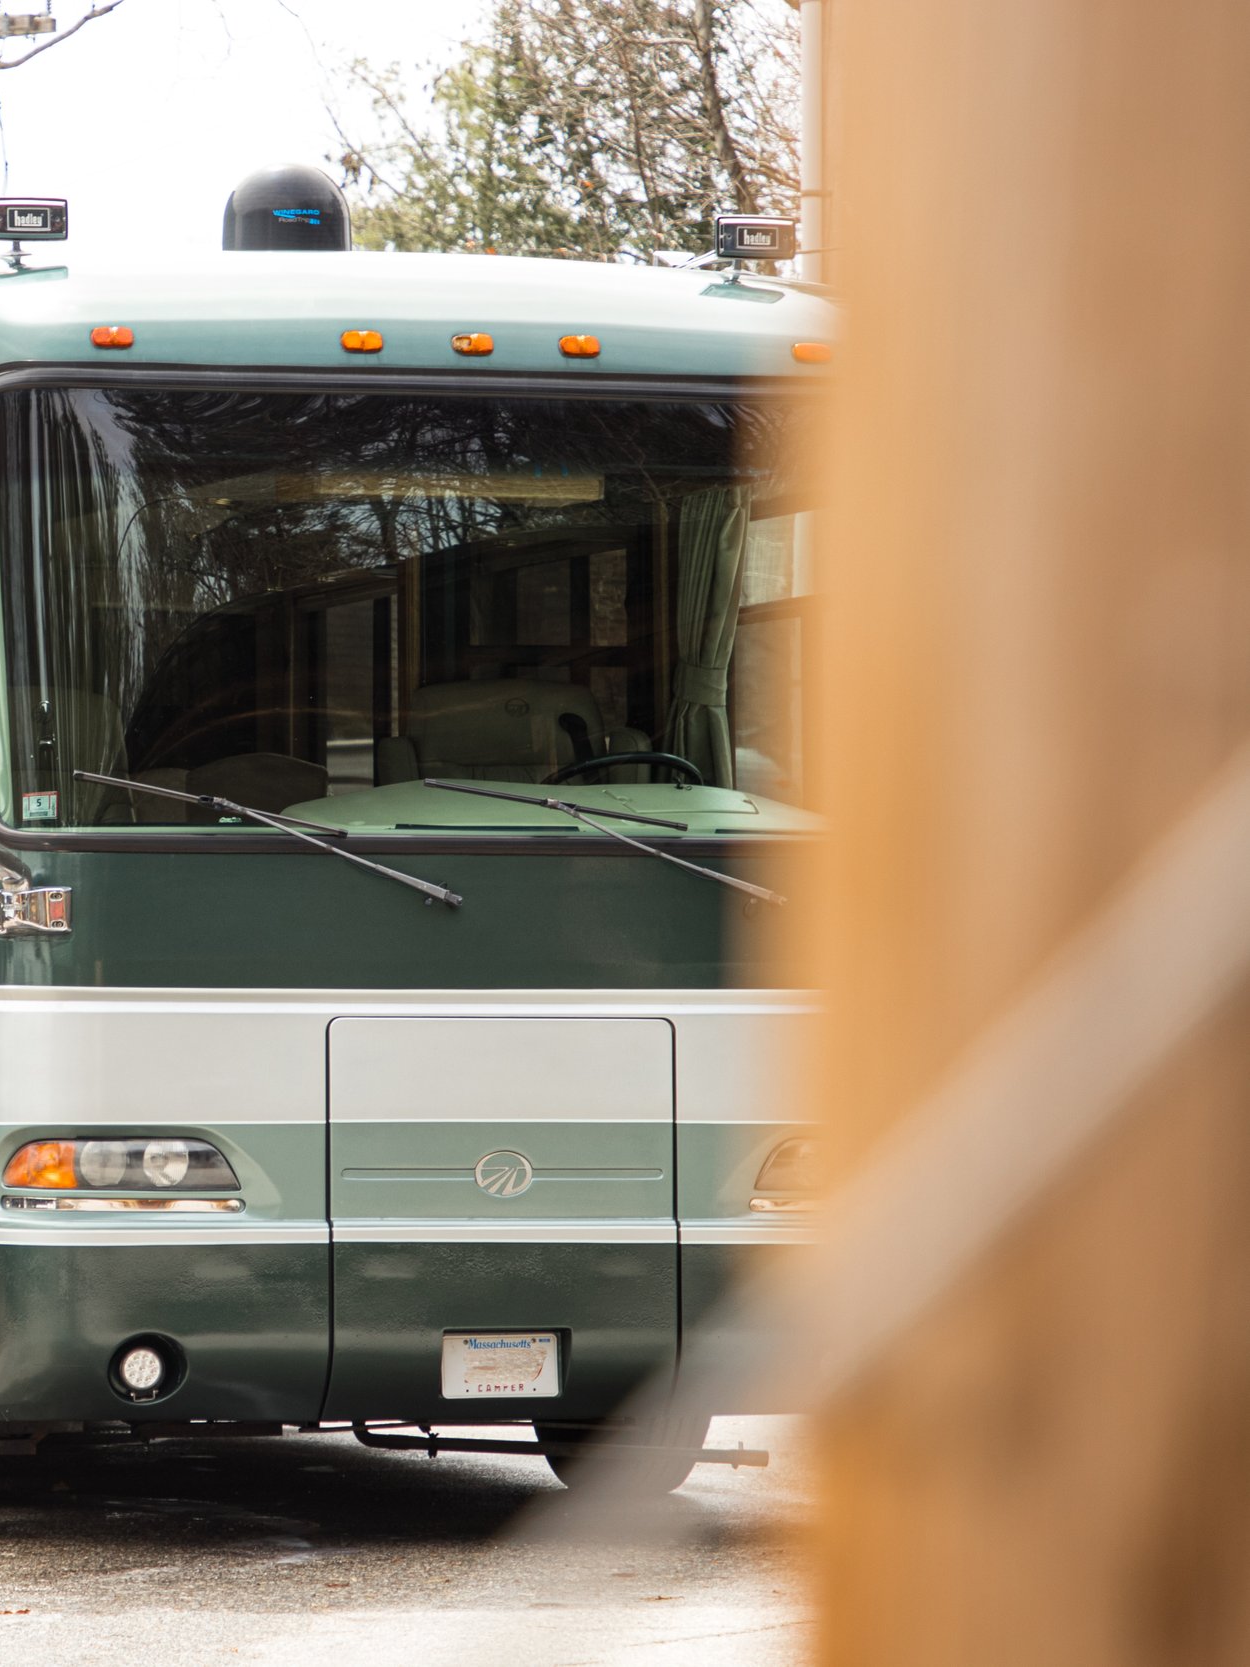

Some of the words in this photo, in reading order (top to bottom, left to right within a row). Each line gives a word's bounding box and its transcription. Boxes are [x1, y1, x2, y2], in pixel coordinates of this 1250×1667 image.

[14, 209, 43, 227] hadley
[743, 229, 771, 246] hadley
[468, 1338, 532, 1349] Massachusetts
[477, 1383, 524, 1393] CAMPER
